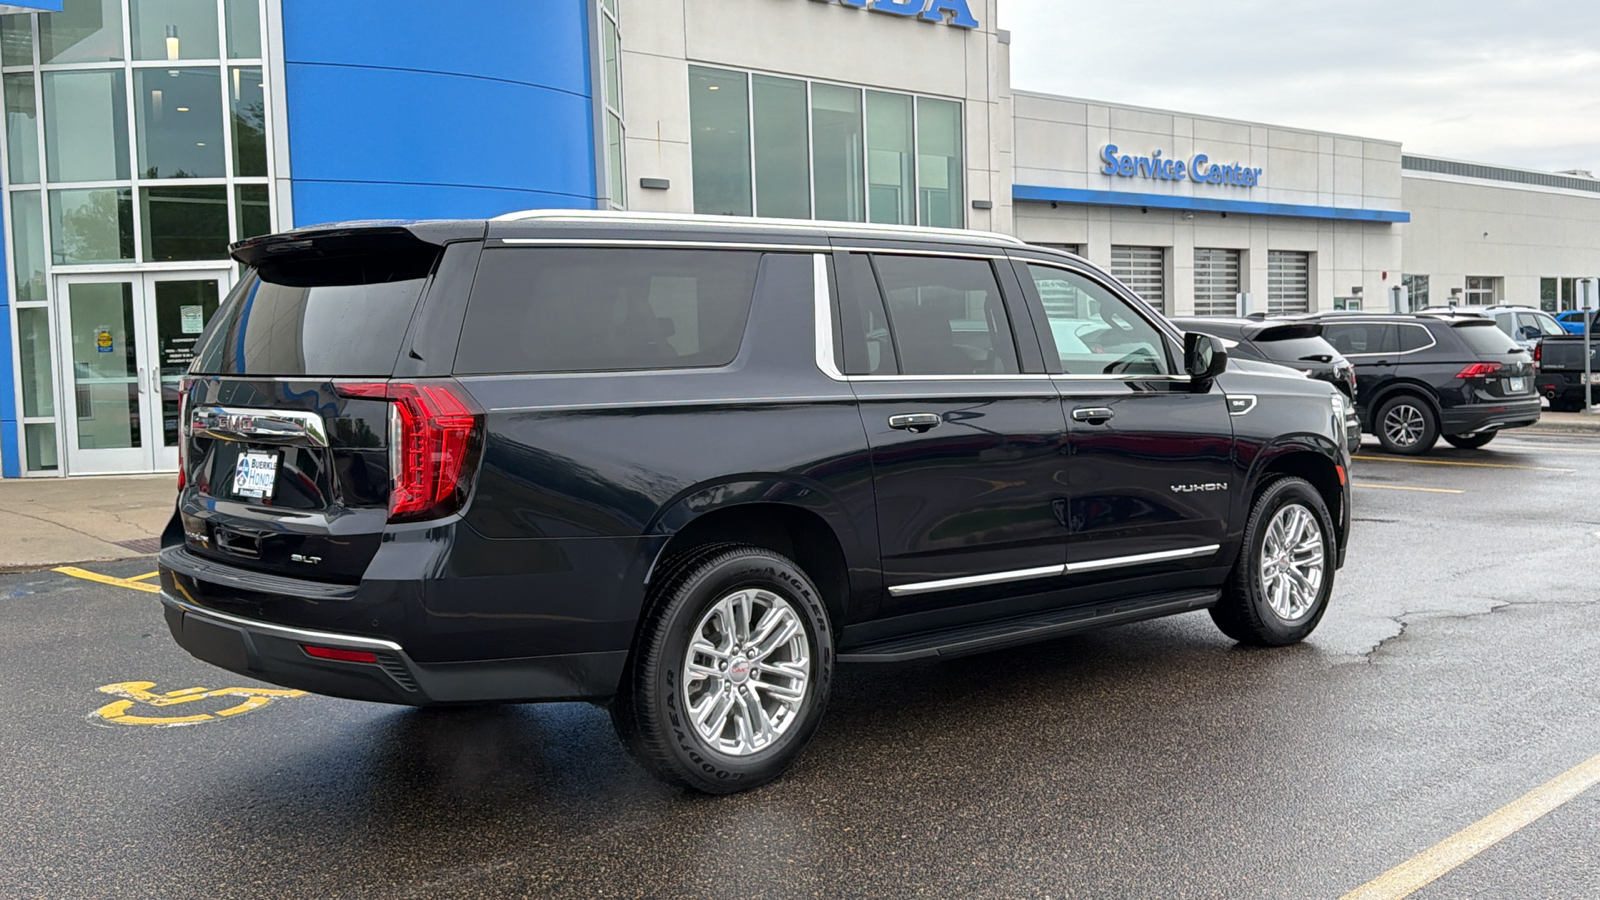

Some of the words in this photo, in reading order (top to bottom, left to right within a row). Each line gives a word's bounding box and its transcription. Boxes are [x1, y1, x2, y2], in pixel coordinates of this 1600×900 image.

[1100, 143, 1186, 181] Service
[1188, 153, 1263, 187] Center
[217, 415, 257, 433] GMC
[251, 458, 277, 471] BUERKLE
[248, 469, 275, 487] HONDA
[1170, 482, 1228, 493] YUKON
[290, 553, 322, 565] SLT
[662, 669, 746, 780] GOODYEAR
